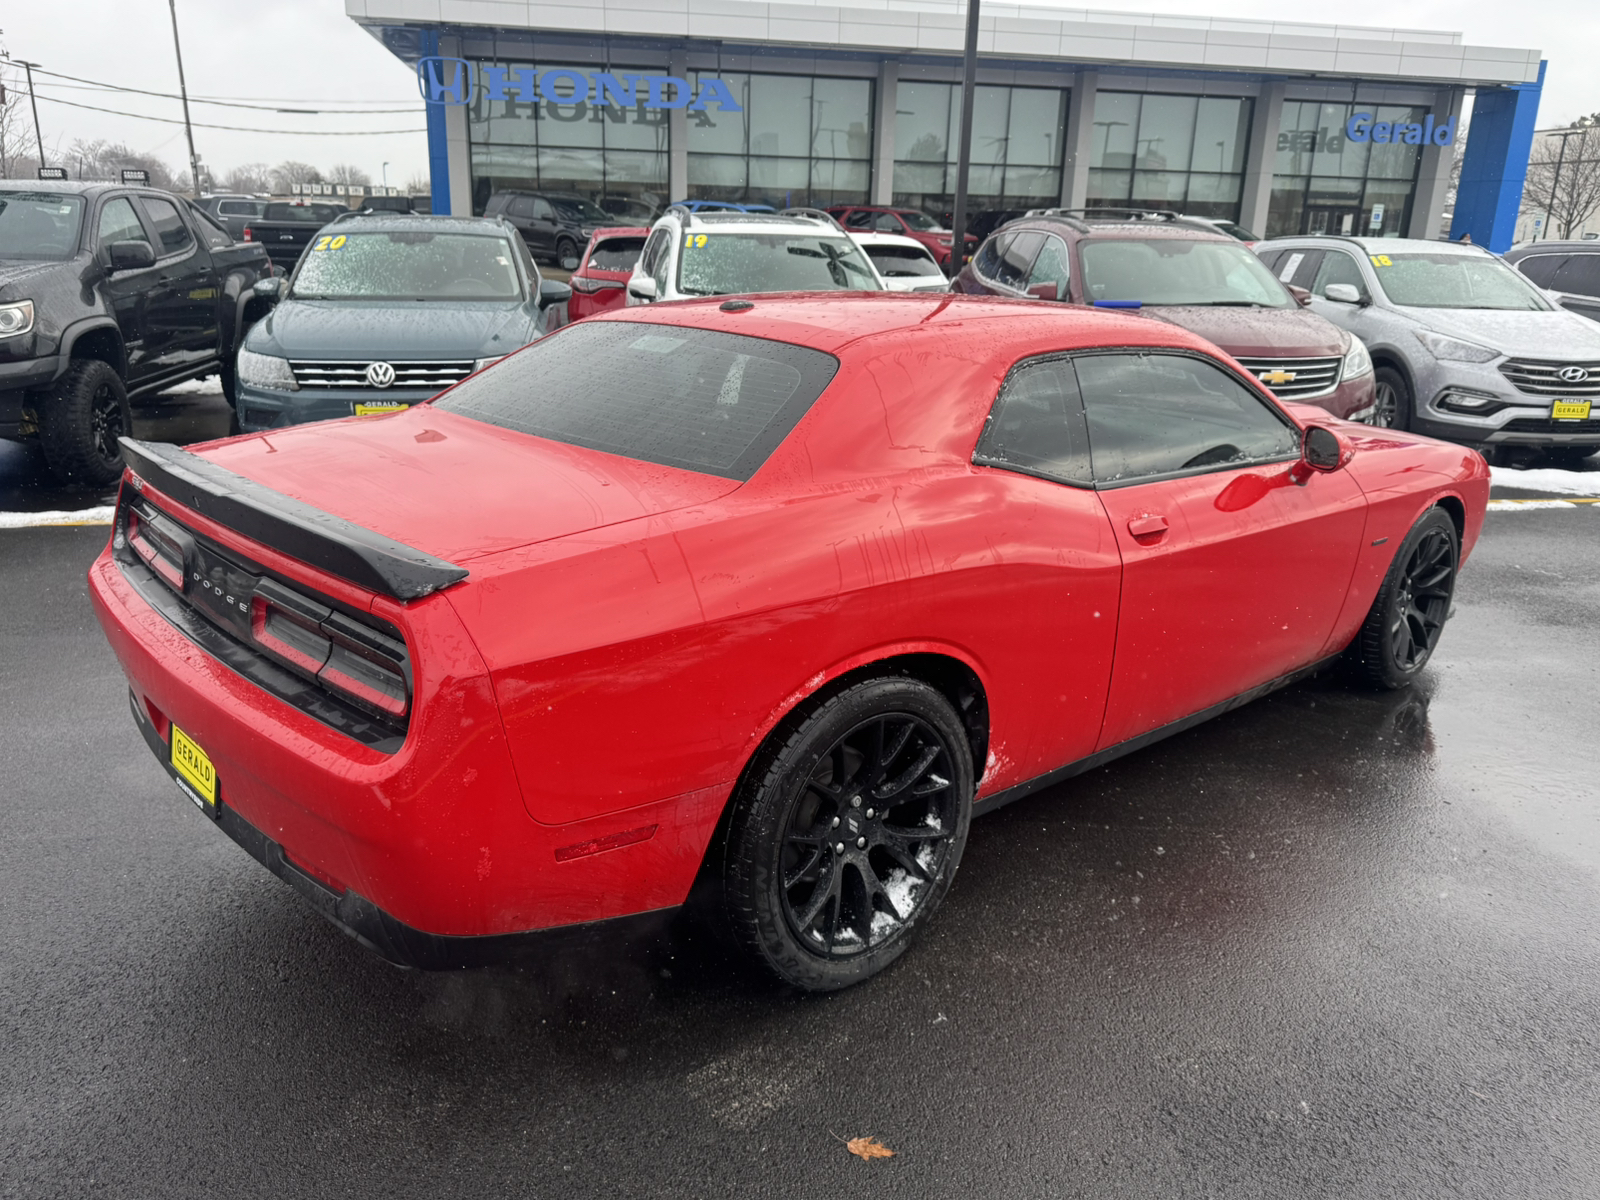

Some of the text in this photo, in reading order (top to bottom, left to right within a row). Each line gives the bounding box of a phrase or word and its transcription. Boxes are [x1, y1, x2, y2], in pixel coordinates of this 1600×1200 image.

[483, 66, 743, 112] HONDA
[1346, 112, 1457, 147] Gerald
[313, 235, 348, 251] 20
[684, 234, 709, 249] 19
[1369, 254, 1393, 268] 18
[193, 572, 248, 613] DODGE
[176, 738, 211, 782] GERALD
